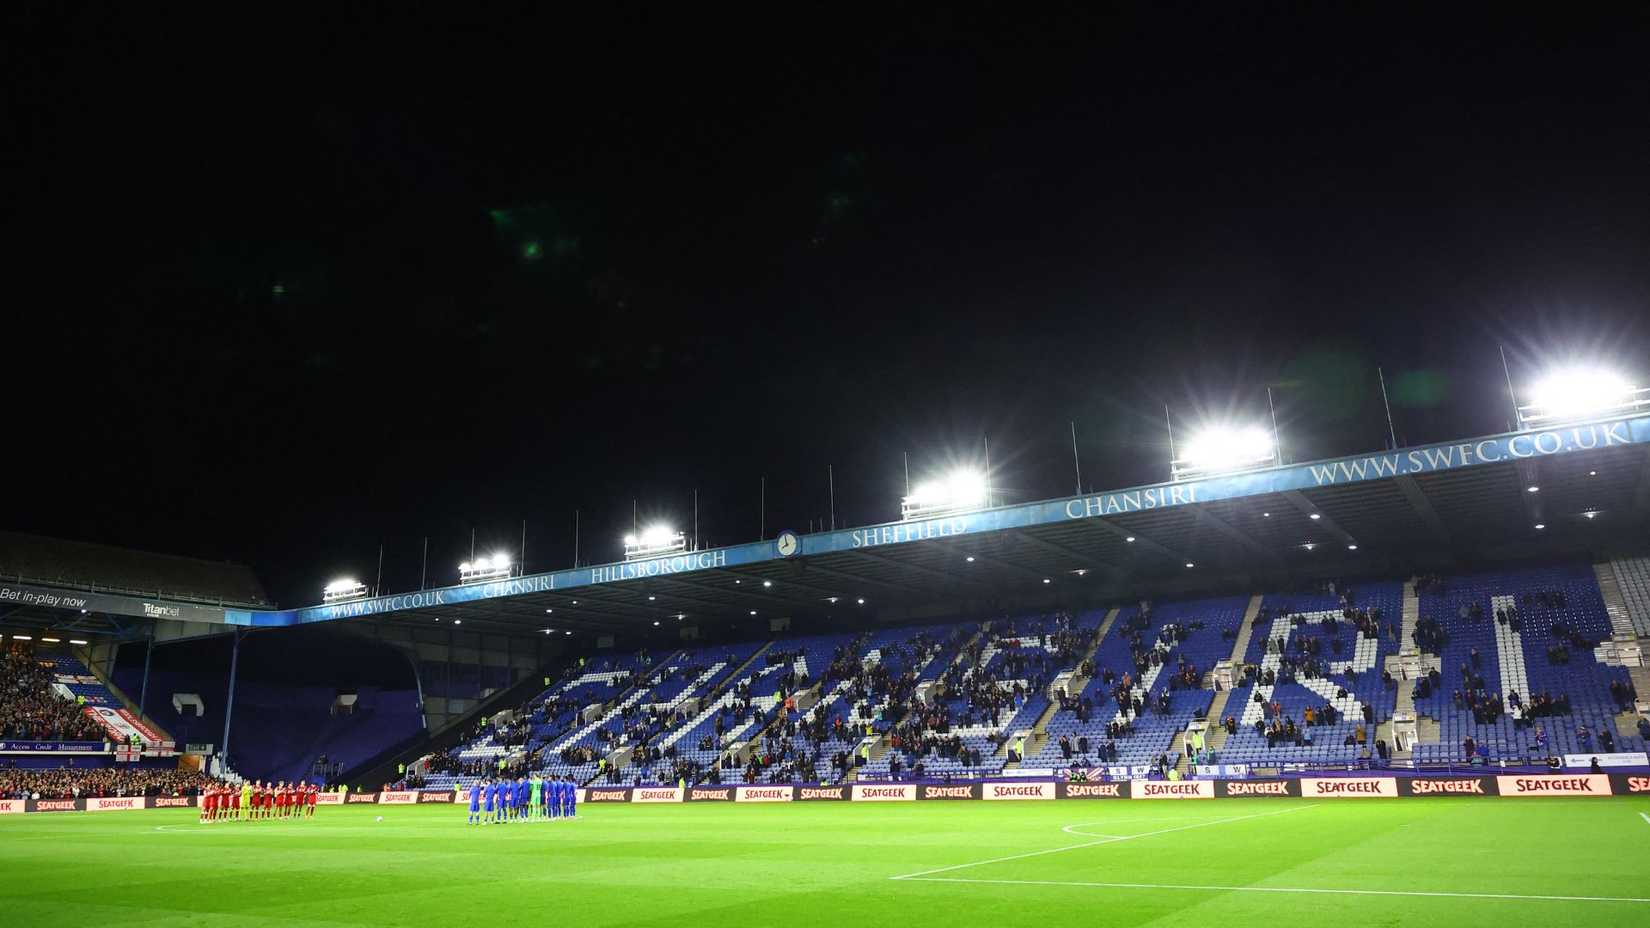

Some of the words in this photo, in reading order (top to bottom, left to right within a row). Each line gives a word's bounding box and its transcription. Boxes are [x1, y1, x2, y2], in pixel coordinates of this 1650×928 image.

[1310, 422, 1630, 485] WWW.SWFC.CO.UK
[1066, 485, 1197, 519] CHANSIRI
[850, 517, 969, 547] SHEFFIELD
[592, 550, 727, 584] HILLSBOROUGH
[482, 575, 555, 599] CHANSIRI
[1, 588, 20, 601] Bet
[23, 591, 61, 607] in-play
[62, 598, 87, 609] now
[331, 590, 445, 618] WWW.SWFC.CO.UK
[1067, 784, 1120, 796] SEATGEEK
[1144, 784, 1200, 795] SEATGEEK
[1227, 781, 1289, 795] SEATGEEK
[1317, 781, 1381, 793] SEATGEEK
[1411, 779, 1483, 794] SEATGEEK
[1517, 778, 1592, 791] SEATGEEK
[592, 791, 626, 800] SEATGEEK
[641, 791, 675, 799] SEATGEEK
[691, 789, 729, 800] SEATGEEK
[745, 789, 783, 799] SEATGEEK
[801, 788, 842, 799] SEATGEEK
[862, 788, 905, 797] SEATGEEK
[925, 786, 973, 798] SEATGEEK
[994, 786, 1043, 796] SEATGEEK
[37, 801, 76, 810] SEATGEEK
